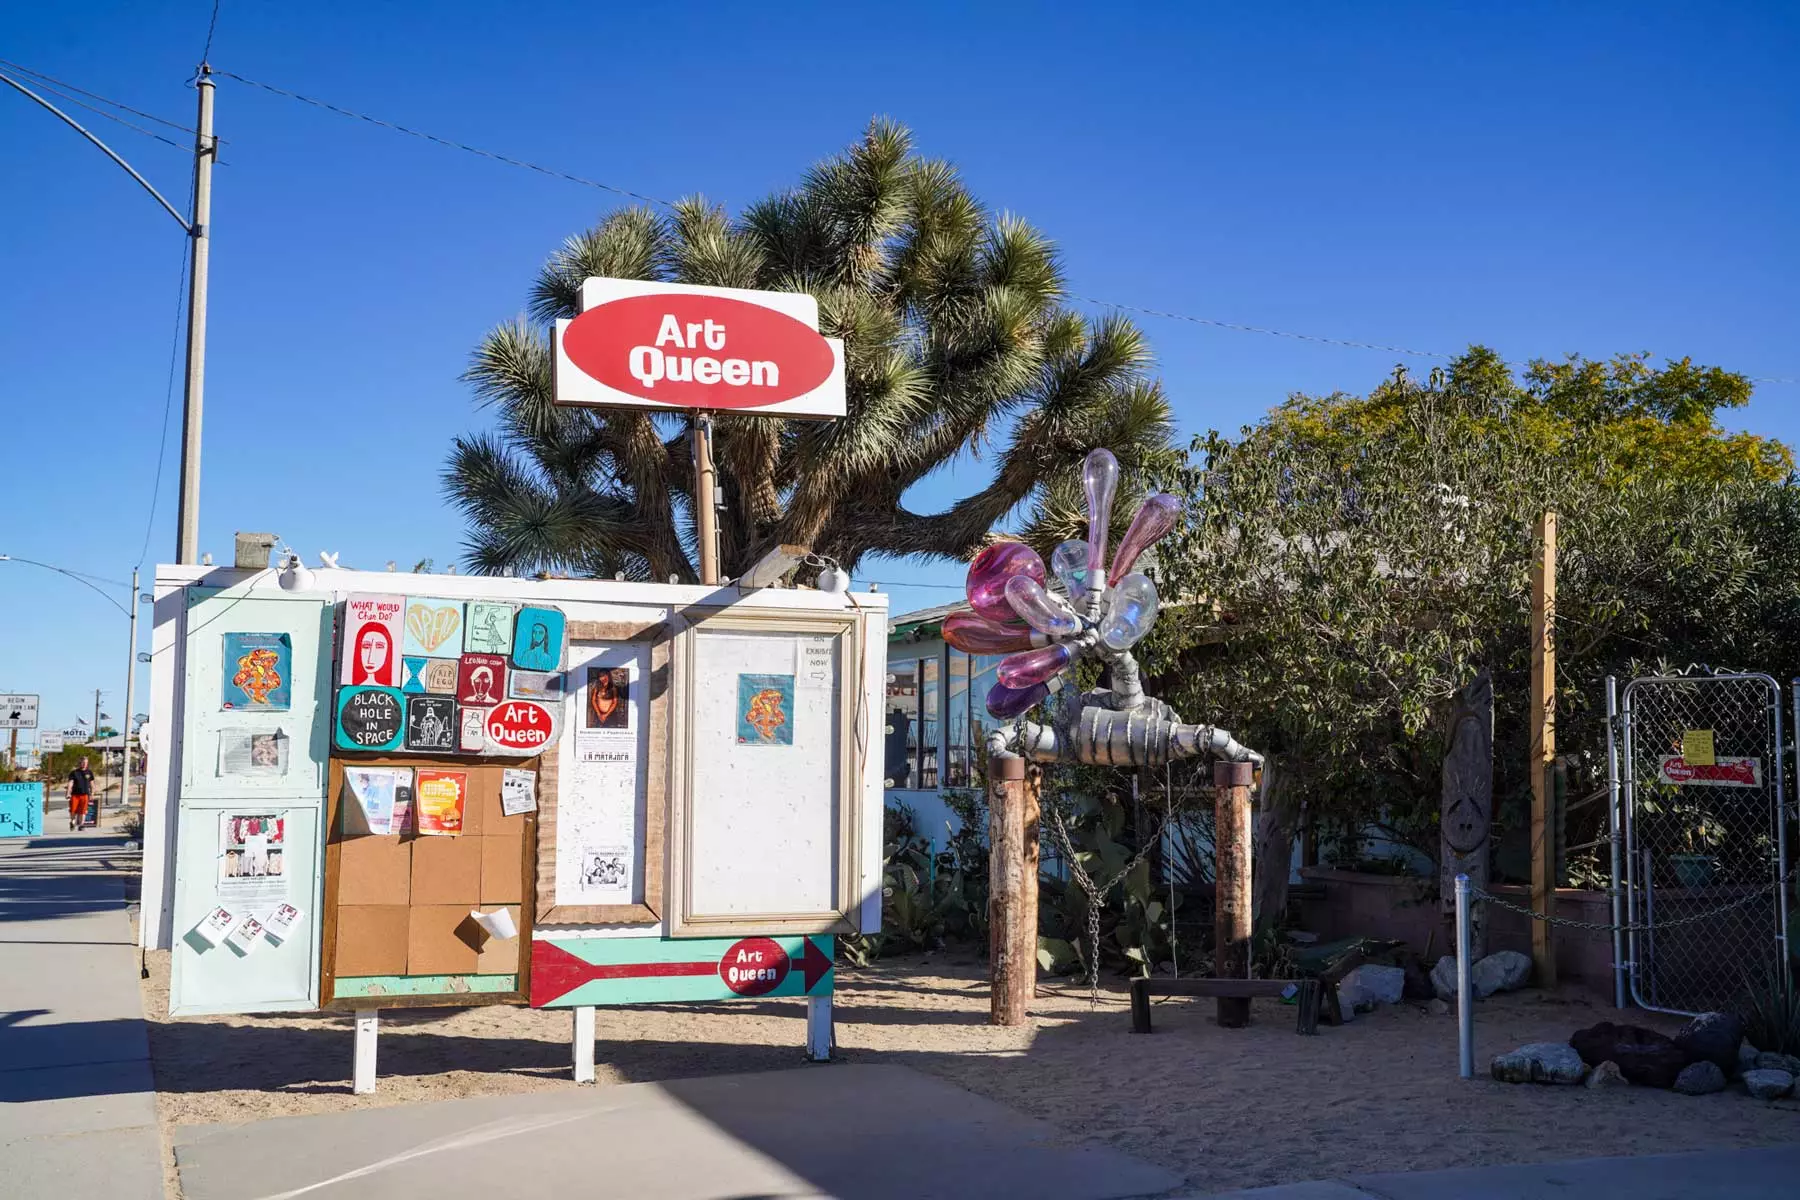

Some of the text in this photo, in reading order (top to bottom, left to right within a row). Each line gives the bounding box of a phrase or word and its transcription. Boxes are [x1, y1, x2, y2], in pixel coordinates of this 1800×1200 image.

[655, 314, 726, 350] Art
[629, 346, 779, 388] Queen
[350, 600, 400, 612] WHAT WOULD
[378, 612, 393, 621] Do?
[408, 608, 458, 648] OPEN
[354, 693, 394, 706] BLACK
[360, 708, 391, 720] HOLE
[504, 704, 539, 724] Art
[366, 722, 378, 730] IN
[491, 723, 546, 742] Queen
[356, 729, 393, 745] SPACE
[737, 949, 763, 964] Art
[728, 967, 776, 984] Queen
